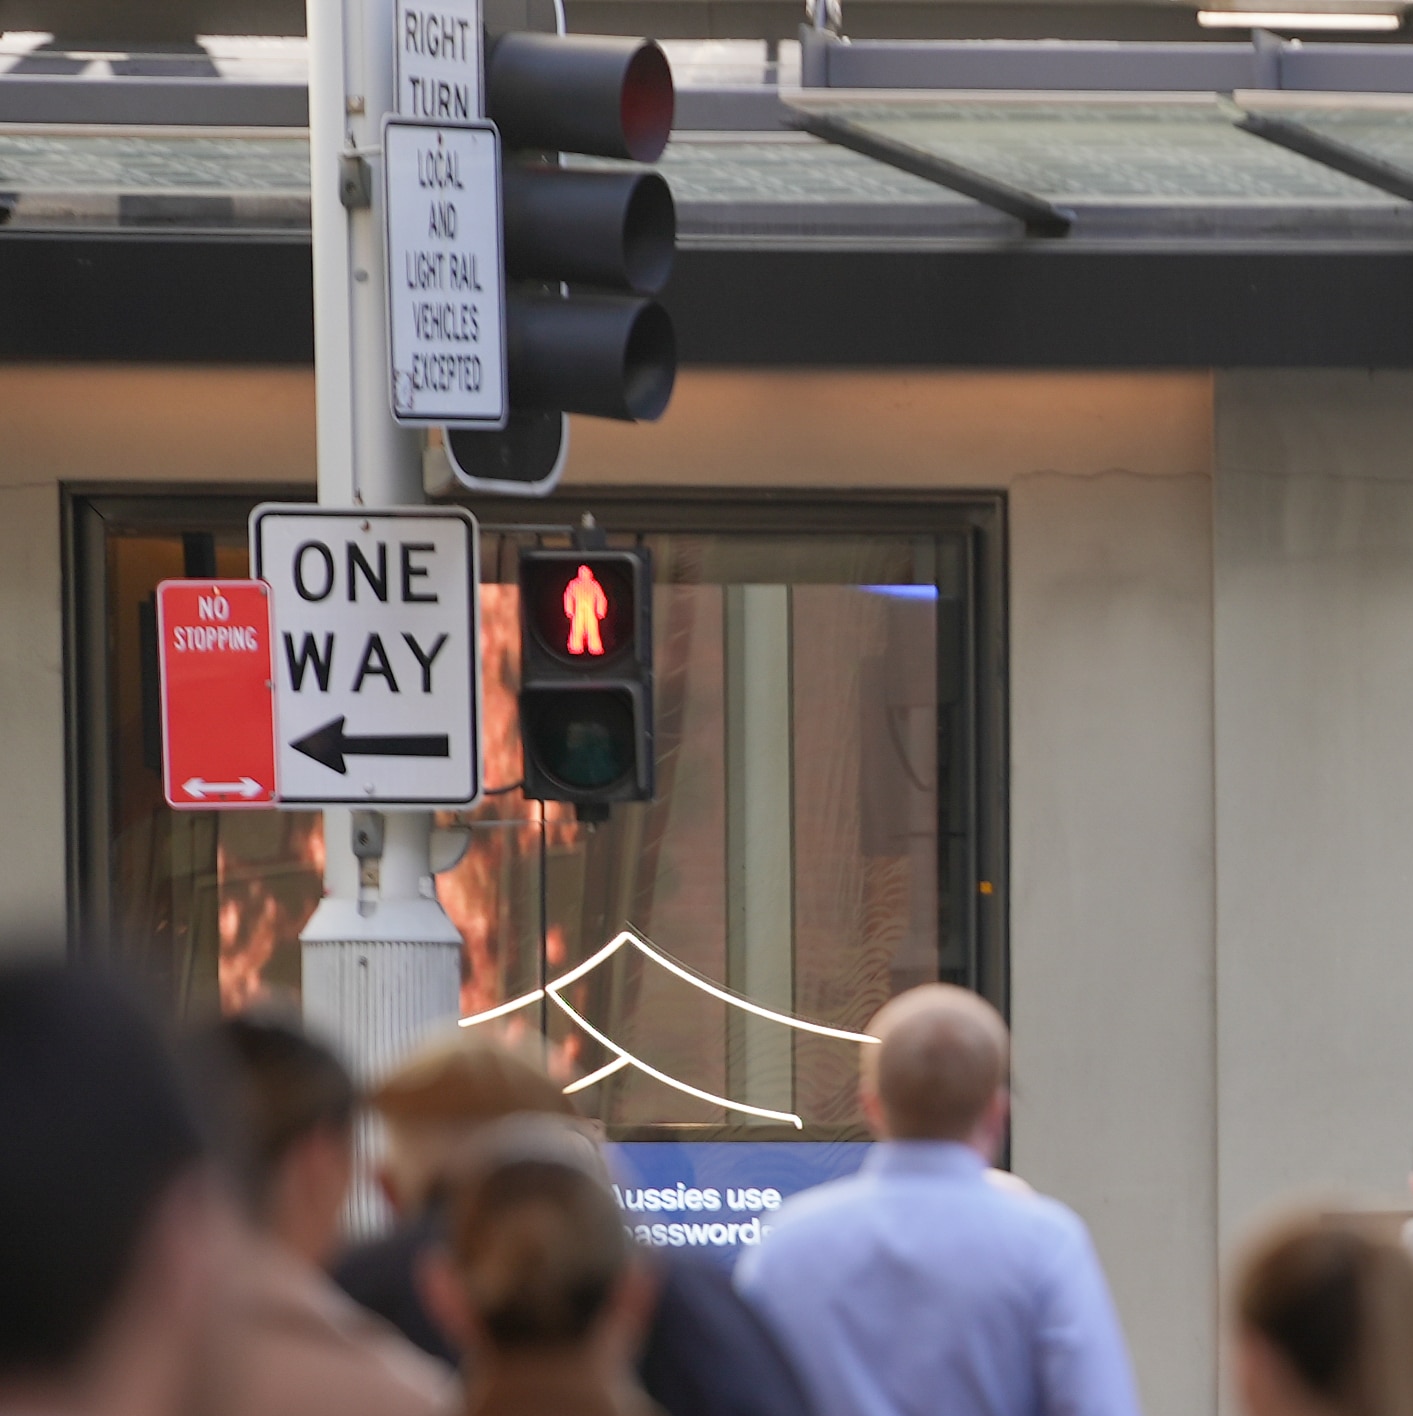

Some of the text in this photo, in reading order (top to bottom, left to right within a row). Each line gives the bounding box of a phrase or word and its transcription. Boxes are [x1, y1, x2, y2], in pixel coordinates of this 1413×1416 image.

[405, 10, 470, 63] RIGHT
[408, 76, 468, 119] TURN
[417, 147, 464, 190] LOCAL
[428, 199, 457, 240] AND
[405, 250, 482, 292] LIGHT RAIL
[411, 302, 481, 343] VEHICLES
[412, 354, 482, 393] EXCEPTED
[292, 540, 439, 602] ONE
[198, 594, 230, 621] NO
[173, 625, 259, 652] STOPPING
[282, 630, 449, 693] WAY
[726, 1187, 782, 1212] use
